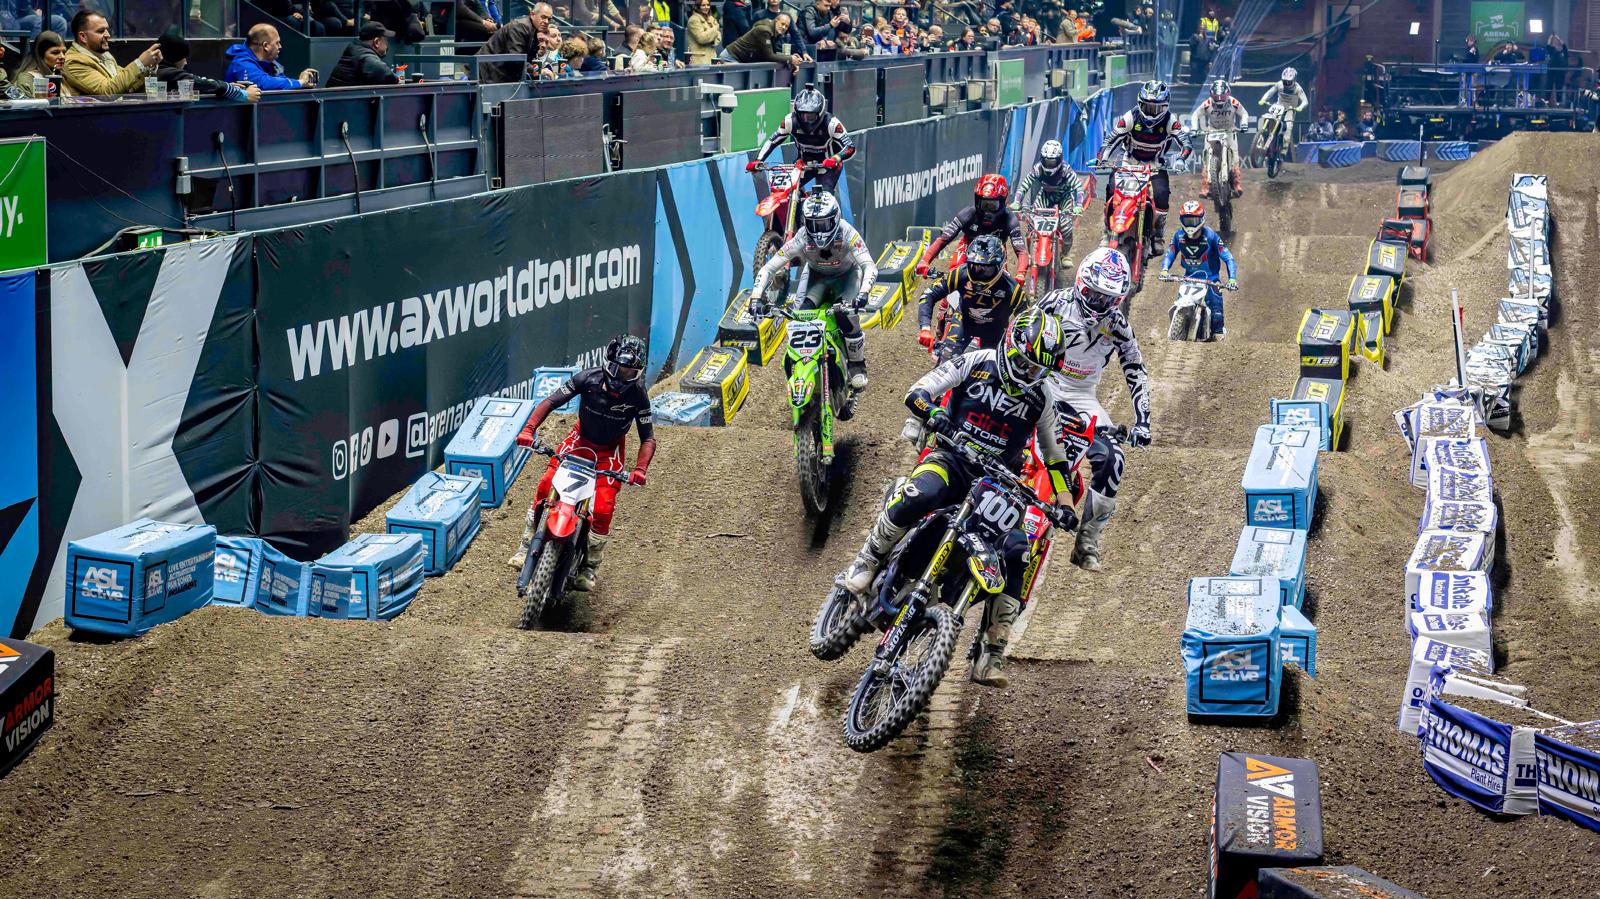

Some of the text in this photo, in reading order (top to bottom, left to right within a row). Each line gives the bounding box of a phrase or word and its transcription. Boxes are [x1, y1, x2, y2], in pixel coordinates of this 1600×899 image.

[873, 153, 983, 209] www.axworldtour.com
[1184, 286, 1204, 296] 17
[286, 243, 641, 383] www.axworldtour.com
[789, 330, 824, 348] 23
[962, 420, 1008, 446] STORE
[562, 471, 590, 493] 7
[974, 490, 1020, 533] 100
[1253, 513, 1289, 522] active
[1254, 499, 1288, 514] ASL
[81, 565, 126, 591] ASL
[81, 585, 124, 602] active
[1211, 648, 1261, 671] ASL
[1209, 669, 1261, 683] active
[5, 677, 52, 733] ARMOR
[5, 699, 50, 753] VISION
[1428, 714, 1506, 776] THOMAS
[1470, 767, 1501, 792] Plant Hire
[1246, 795, 1270, 845] VISION
[1272, 796, 1297, 850] ARMOR
